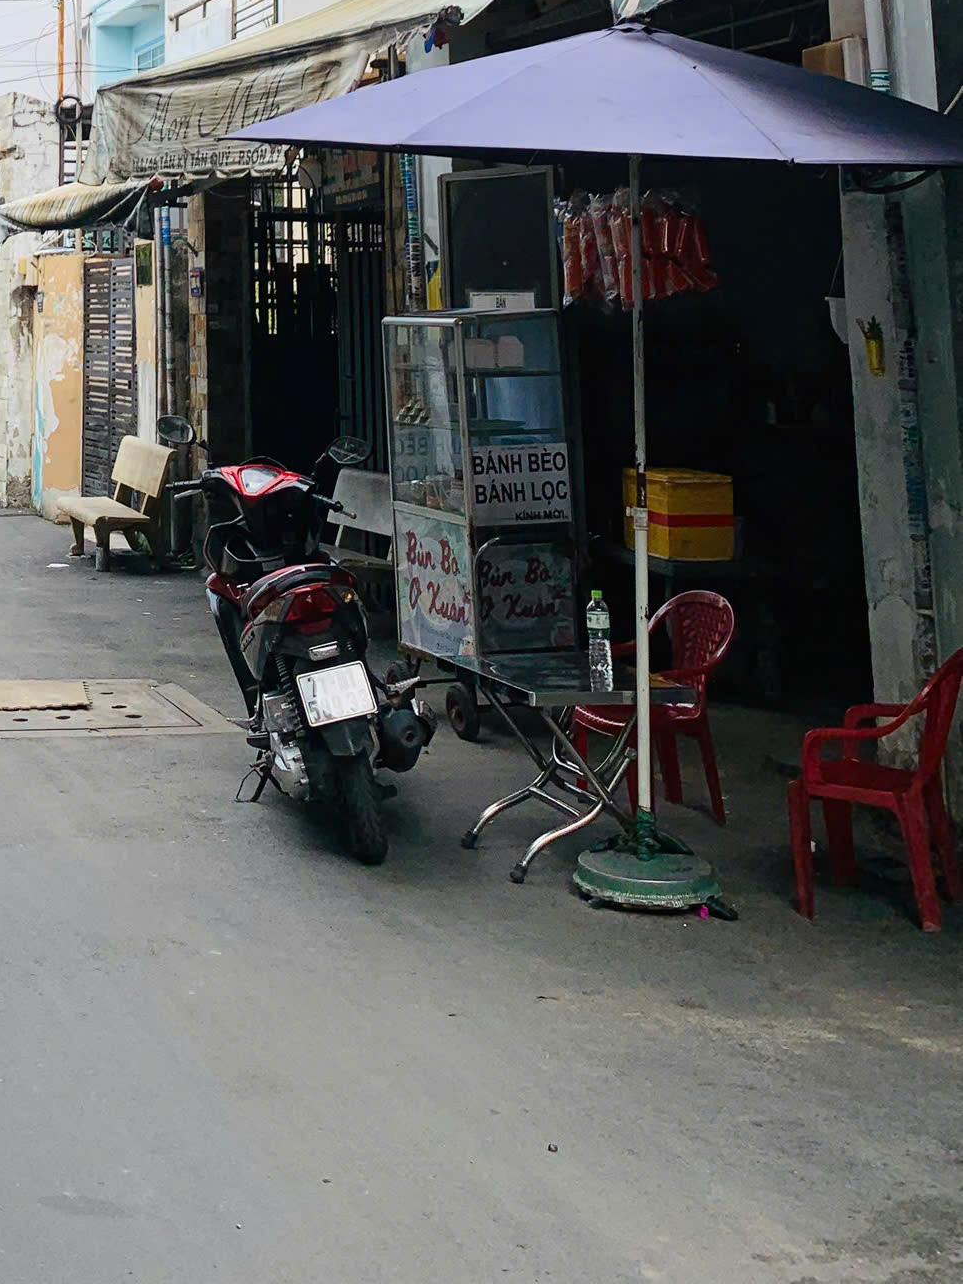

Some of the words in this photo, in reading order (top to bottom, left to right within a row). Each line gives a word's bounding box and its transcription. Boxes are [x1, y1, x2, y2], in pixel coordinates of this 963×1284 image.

[472, 450, 522, 475] BÁNH
[528, 448, 566, 472] BÈO
[475, 479, 526, 504] BÁNH
[532, 480, 568, 505] LỌC
